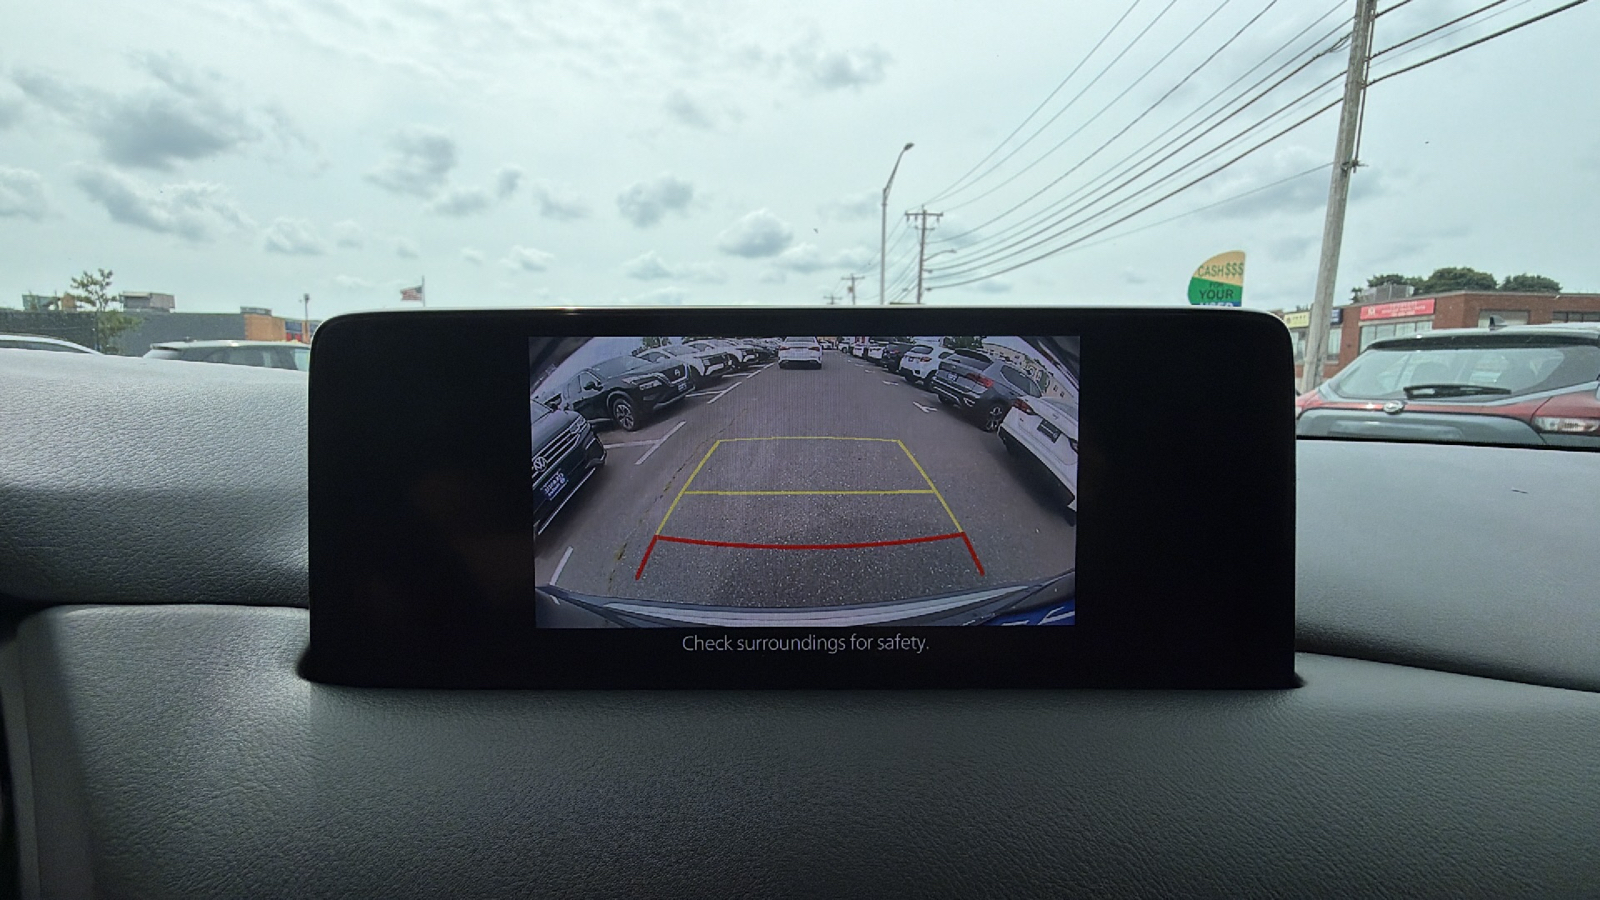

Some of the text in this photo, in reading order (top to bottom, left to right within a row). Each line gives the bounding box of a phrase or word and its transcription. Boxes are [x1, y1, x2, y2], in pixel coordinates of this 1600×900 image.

[1199, 289, 1234, 300] YOUR
[682, 633, 930, 654] Check surroundings for safety.
